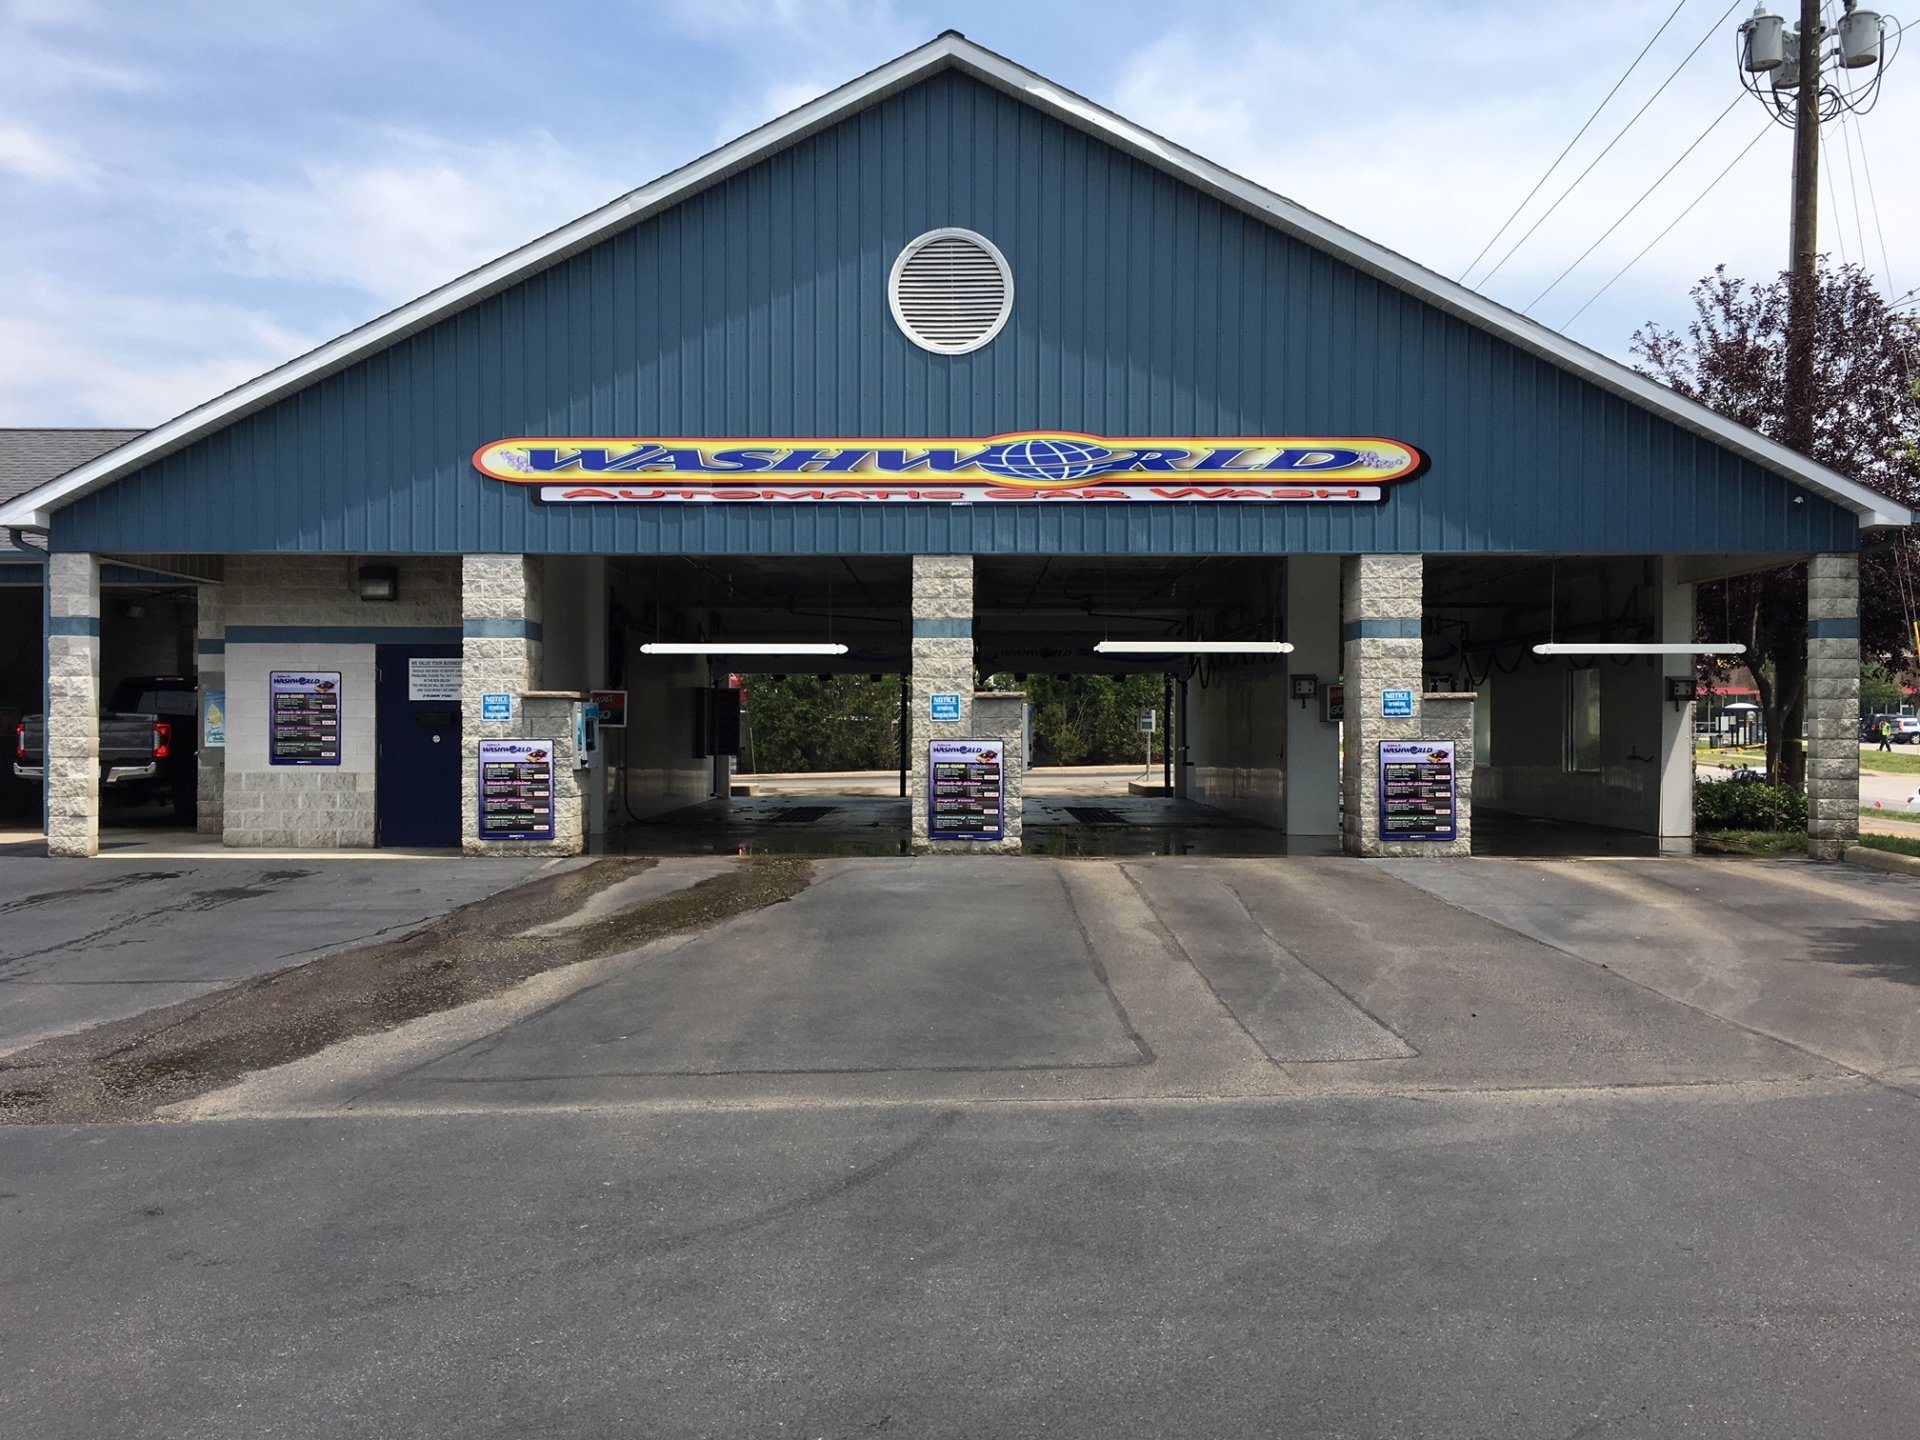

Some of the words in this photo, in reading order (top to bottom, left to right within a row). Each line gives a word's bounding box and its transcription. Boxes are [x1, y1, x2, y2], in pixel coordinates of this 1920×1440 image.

[520, 439, 1361, 481] WASHWORLD
[561, 488, 965, 499] AUTOMATIC
[984, 489, 1132, 499] CAR
[1149, 488, 1360, 499] WASH
